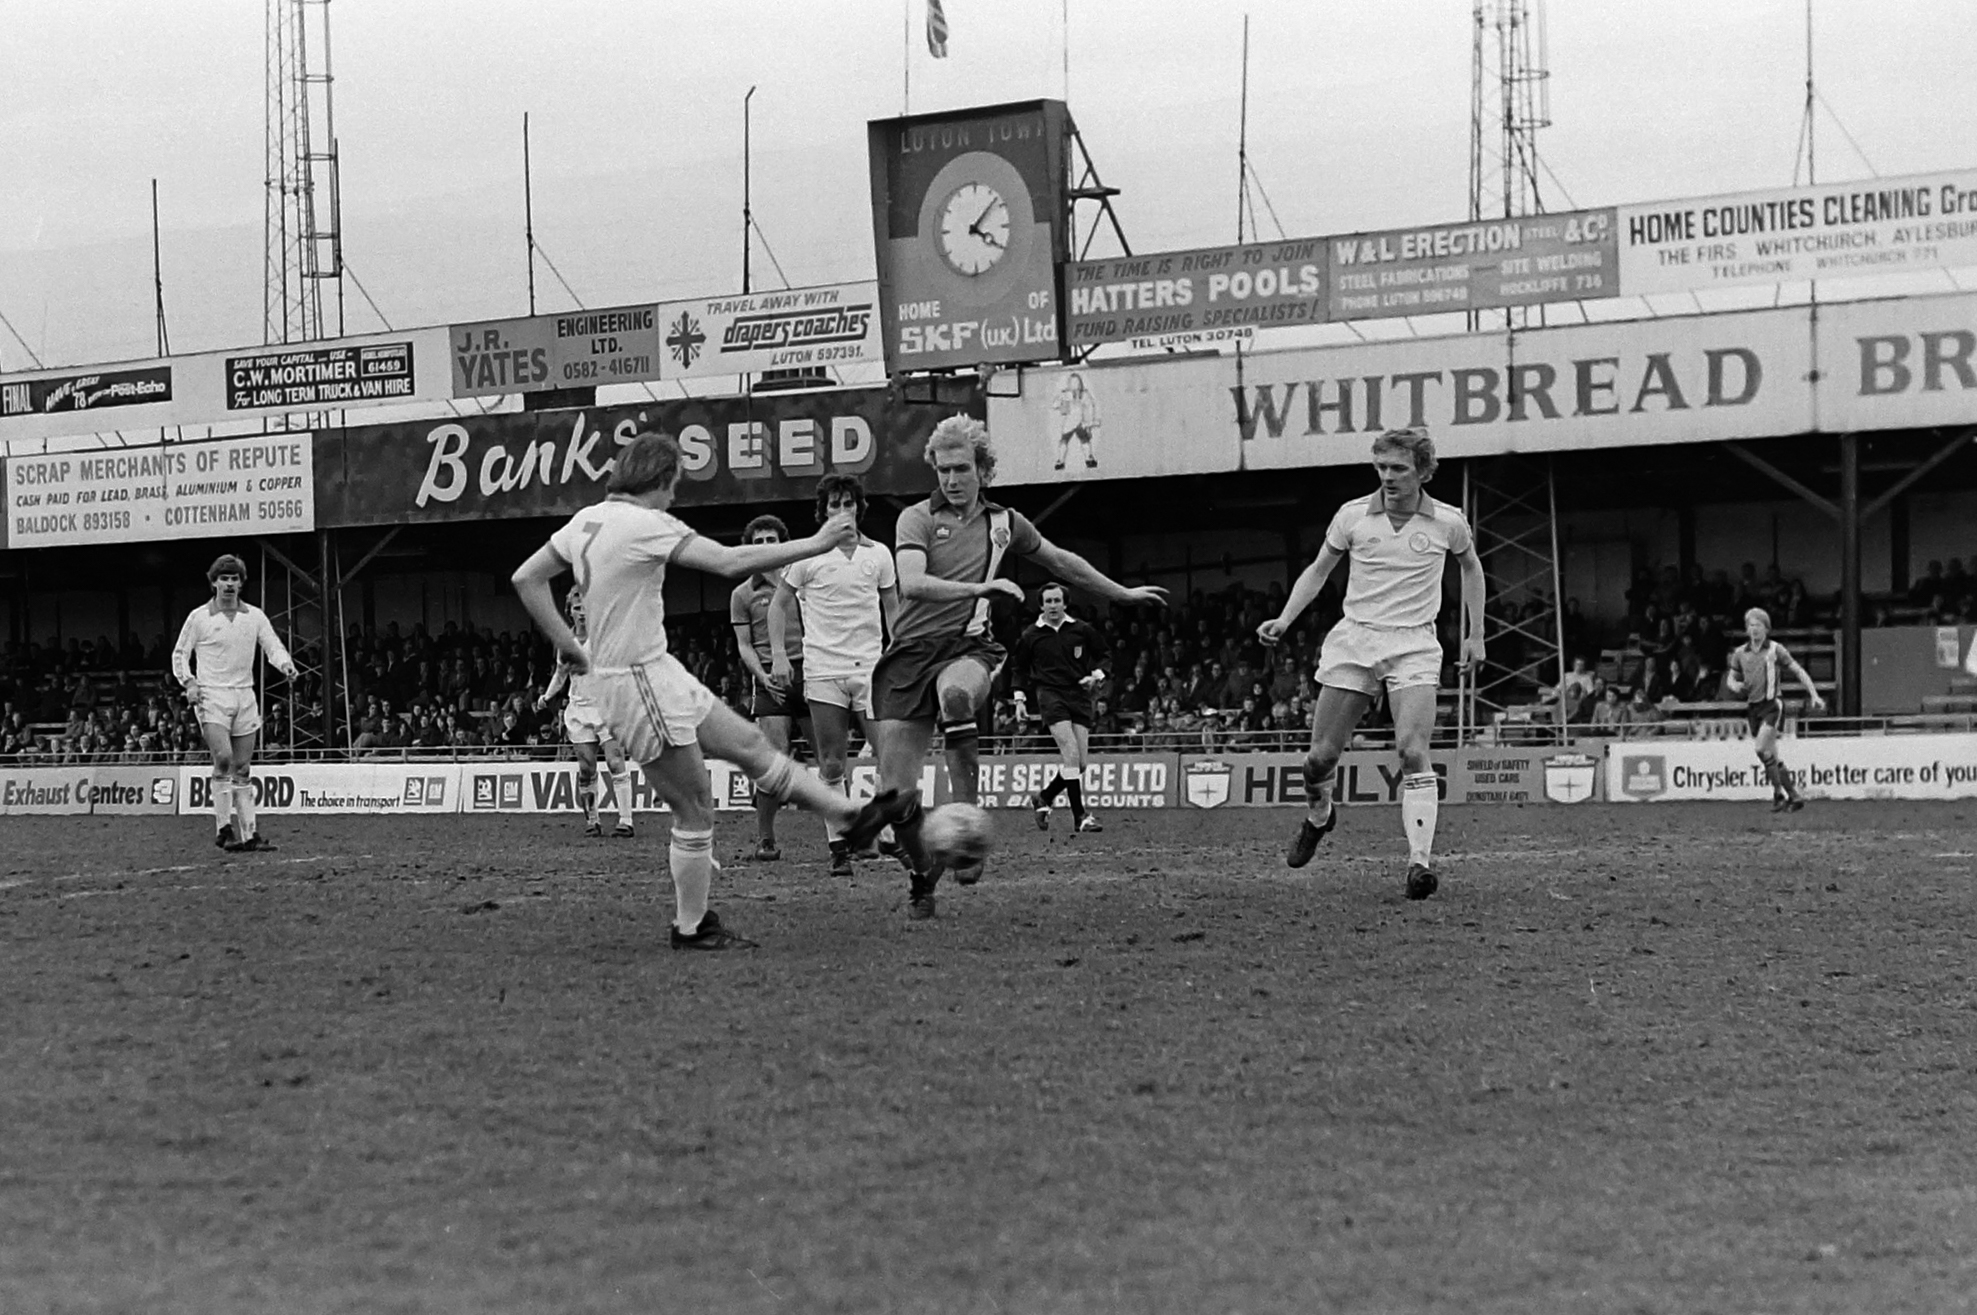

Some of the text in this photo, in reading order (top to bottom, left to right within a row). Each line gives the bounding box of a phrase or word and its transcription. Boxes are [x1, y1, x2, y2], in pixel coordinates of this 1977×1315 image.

[900, 127, 970, 154] LUTON
[1630, 208, 1695, 247] HOME
[1703, 198, 1815, 238] COUNTIES
[1823, 186, 1931, 227] CLEANING
[1401, 223, 1522, 261] ERECTION
[1658, 249, 1690, 267] THE
[1696, 242, 1737, 261] FIRS
[1075, 243, 1315, 282] THE TIME IS RIGHT TO JOIN
[1711, 259, 1791, 280] TELEPHONE
[1070, 264, 1320, 317] HATTERS POOLS
[1338, 272, 1378, 291] STEEL
[706, 290, 840, 316] TRAVEL AWAY WITH
[898, 290, 1049, 322] HOME OF
[556, 309, 654, 339] ENGINEERING
[899, 320, 978, 355] SKF
[1023, 312, 1058, 345] Ltd
[1073, 299, 1320, 339] FUND RAISING SPECIALISTS!
[591, 337, 624, 355] LTD.
[1159, 333, 1203, 348] LUTON
[233, 349, 347, 370] SAVE YOUR CAPITAL USE
[270, 360, 357, 386] MORTIMER
[457, 347, 550, 390] YATES
[771, 349, 813, 366] LUTON
[2, 382, 33, 415] FINAL
[252, 388, 282, 407] LONG
[284, 385, 316, 403] TERM
[318, 382, 353, 401] TRUCK
[361, 379, 383, 396] VAN
[384, 377, 412, 395] HIRE
[1228, 346, 1764, 442] WHITBREAD
[679, 415, 875, 478] SEED
[15, 443, 302, 486] SCRAP MERCHANTS OF REPUTE
[16, 493, 41, 508] CASH
[46, 491, 70, 506] PAID
[76, 489, 97, 504] FOR
[175, 480, 238, 498] ALUMINIUM
[245, 479, 253, 492] &
[258, 475, 302, 492] COPPER
[16, 500, 303, 535] BALDOCK 893158 COTTENHAM 50566
[576, 520, 604, 594] 7
[1120, 762, 1168, 793] LTD
[1467, 759, 1494, 771] SHIELD
[1501, 759, 1530, 771] SAFETY
[1474, 772, 1520, 784] USED CARS
[1810, 763, 1868, 786] better
[1873, 765, 1915, 786] care
[1918, 759, 1941, 784] of
[3, 777, 145, 807] Exhaust Centres
[189, 775, 401, 810] BEORD The choice in transport
